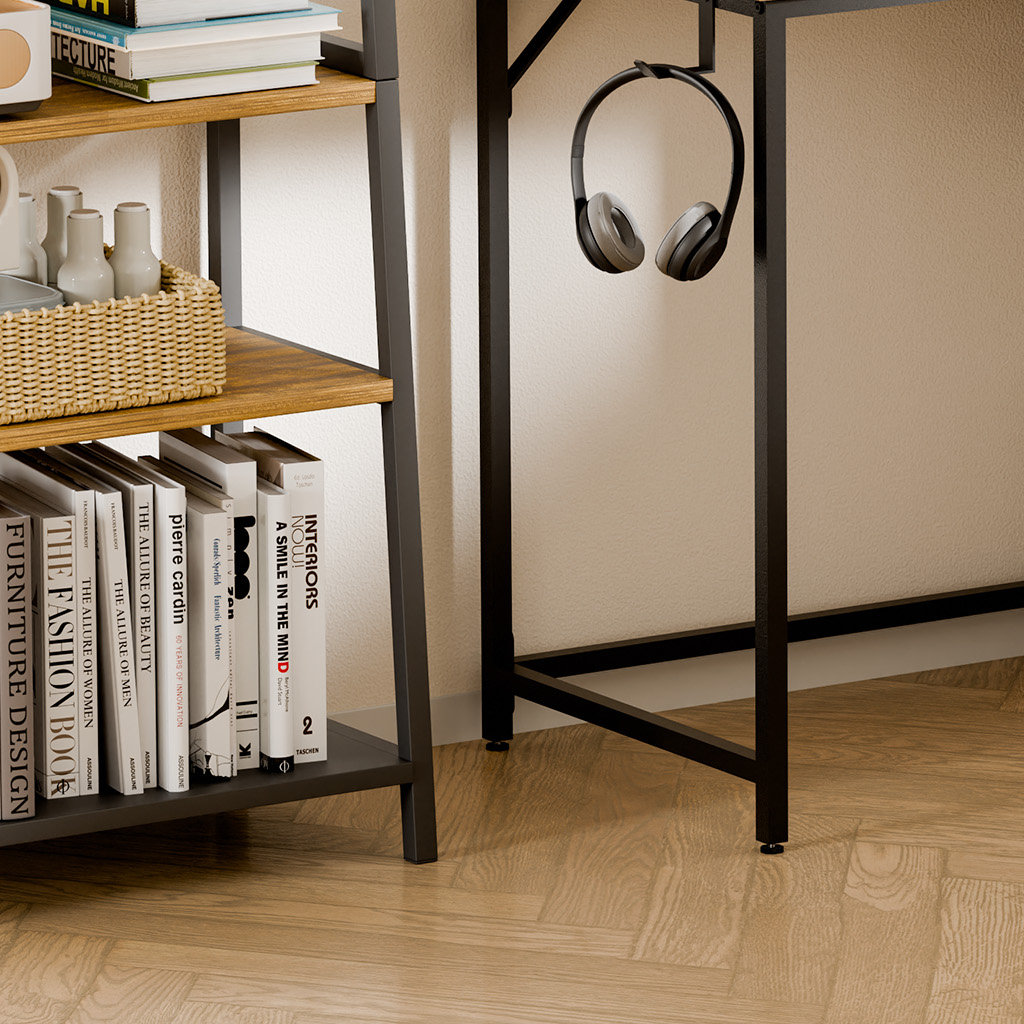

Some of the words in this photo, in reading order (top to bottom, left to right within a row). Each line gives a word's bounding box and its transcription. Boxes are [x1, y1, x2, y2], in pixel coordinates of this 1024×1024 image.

[52, 32, 116, 76] TECTURE
[138, 502, 150, 532] THE
[276, 521, 288, 532] A
[47, 520, 73, 580] THE
[168, 514, 185, 565] pierre
[276, 536, 288, 580] SMILE
[292, 515, 305, 568] NOW!
[139, 536, 150, 591] ALLURE
[304, 514, 319, 610] INTERIORS
[6, 522, 27, 697] FURNITURE
[82, 576, 92, 604] THE
[114, 578, 124, 606] THE
[140, 594, 151, 612] OF
[172, 570, 186, 624] cardin
[214, 595, 222, 622] Fantastic
[276, 584, 288, 599] IN
[82, 606, 92, 656] ALLURE
[116, 607, 128, 658] ALLURE
[277, 602, 289, 630] THE
[48, 585, 75, 708] FASHION
[140, 616, 152, 673] BEAUTY
[176, 634, 182, 644] 60
[278, 634, 290, 674] MIND
[83, 658, 92, 678] OF
[120, 659, 130, 678] OF
[176, 671, 184, 681] OF
[84, 678, 94, 728] WOMEN
[122, 678, 132, 708] MEN
[176, 684, 184, 728] INNOVATION
[302, 716, 313, 736] 2
[8, 706, 28, 815] DESIGN
[50, 716, 76, 797] BOOK
[296, 746, 320, 756] TASCHEN
